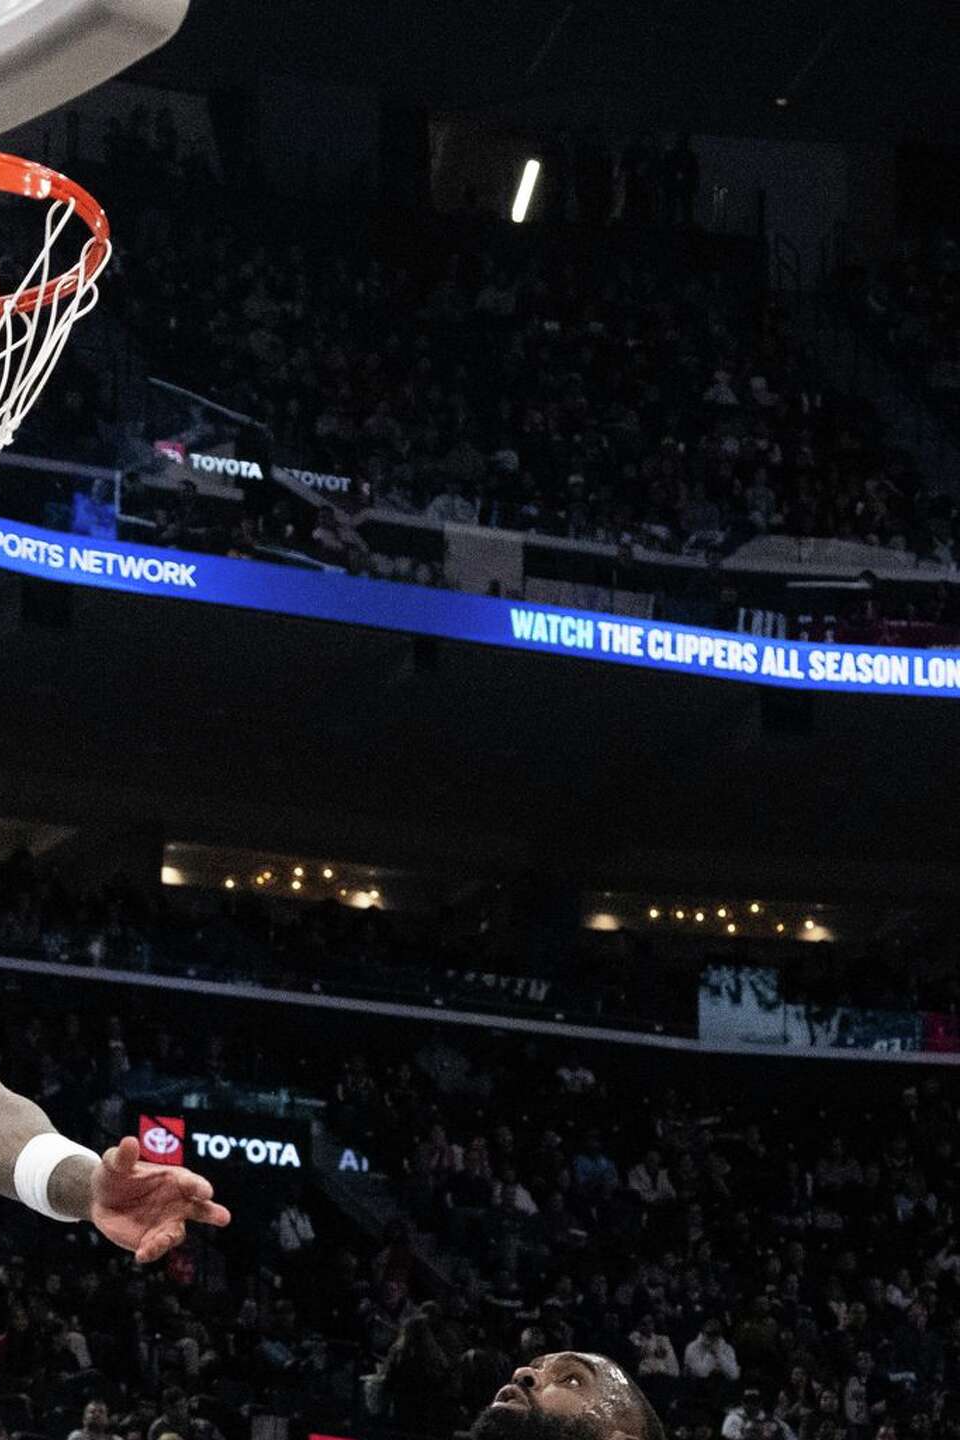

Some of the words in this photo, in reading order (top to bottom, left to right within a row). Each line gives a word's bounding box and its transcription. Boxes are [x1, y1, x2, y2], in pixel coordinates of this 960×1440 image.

[190, 453, 264, 481] TOYOTA
[70, 547, 197, 588] NETWORK
[510, 608, 594, 649] WATCH
[597, 621, 644, 657] THE
[647, 629, 758, 674] CLIPPERS
[760, 646, 805, 680] ALL
[808, 650, 909, 685] SEASON
